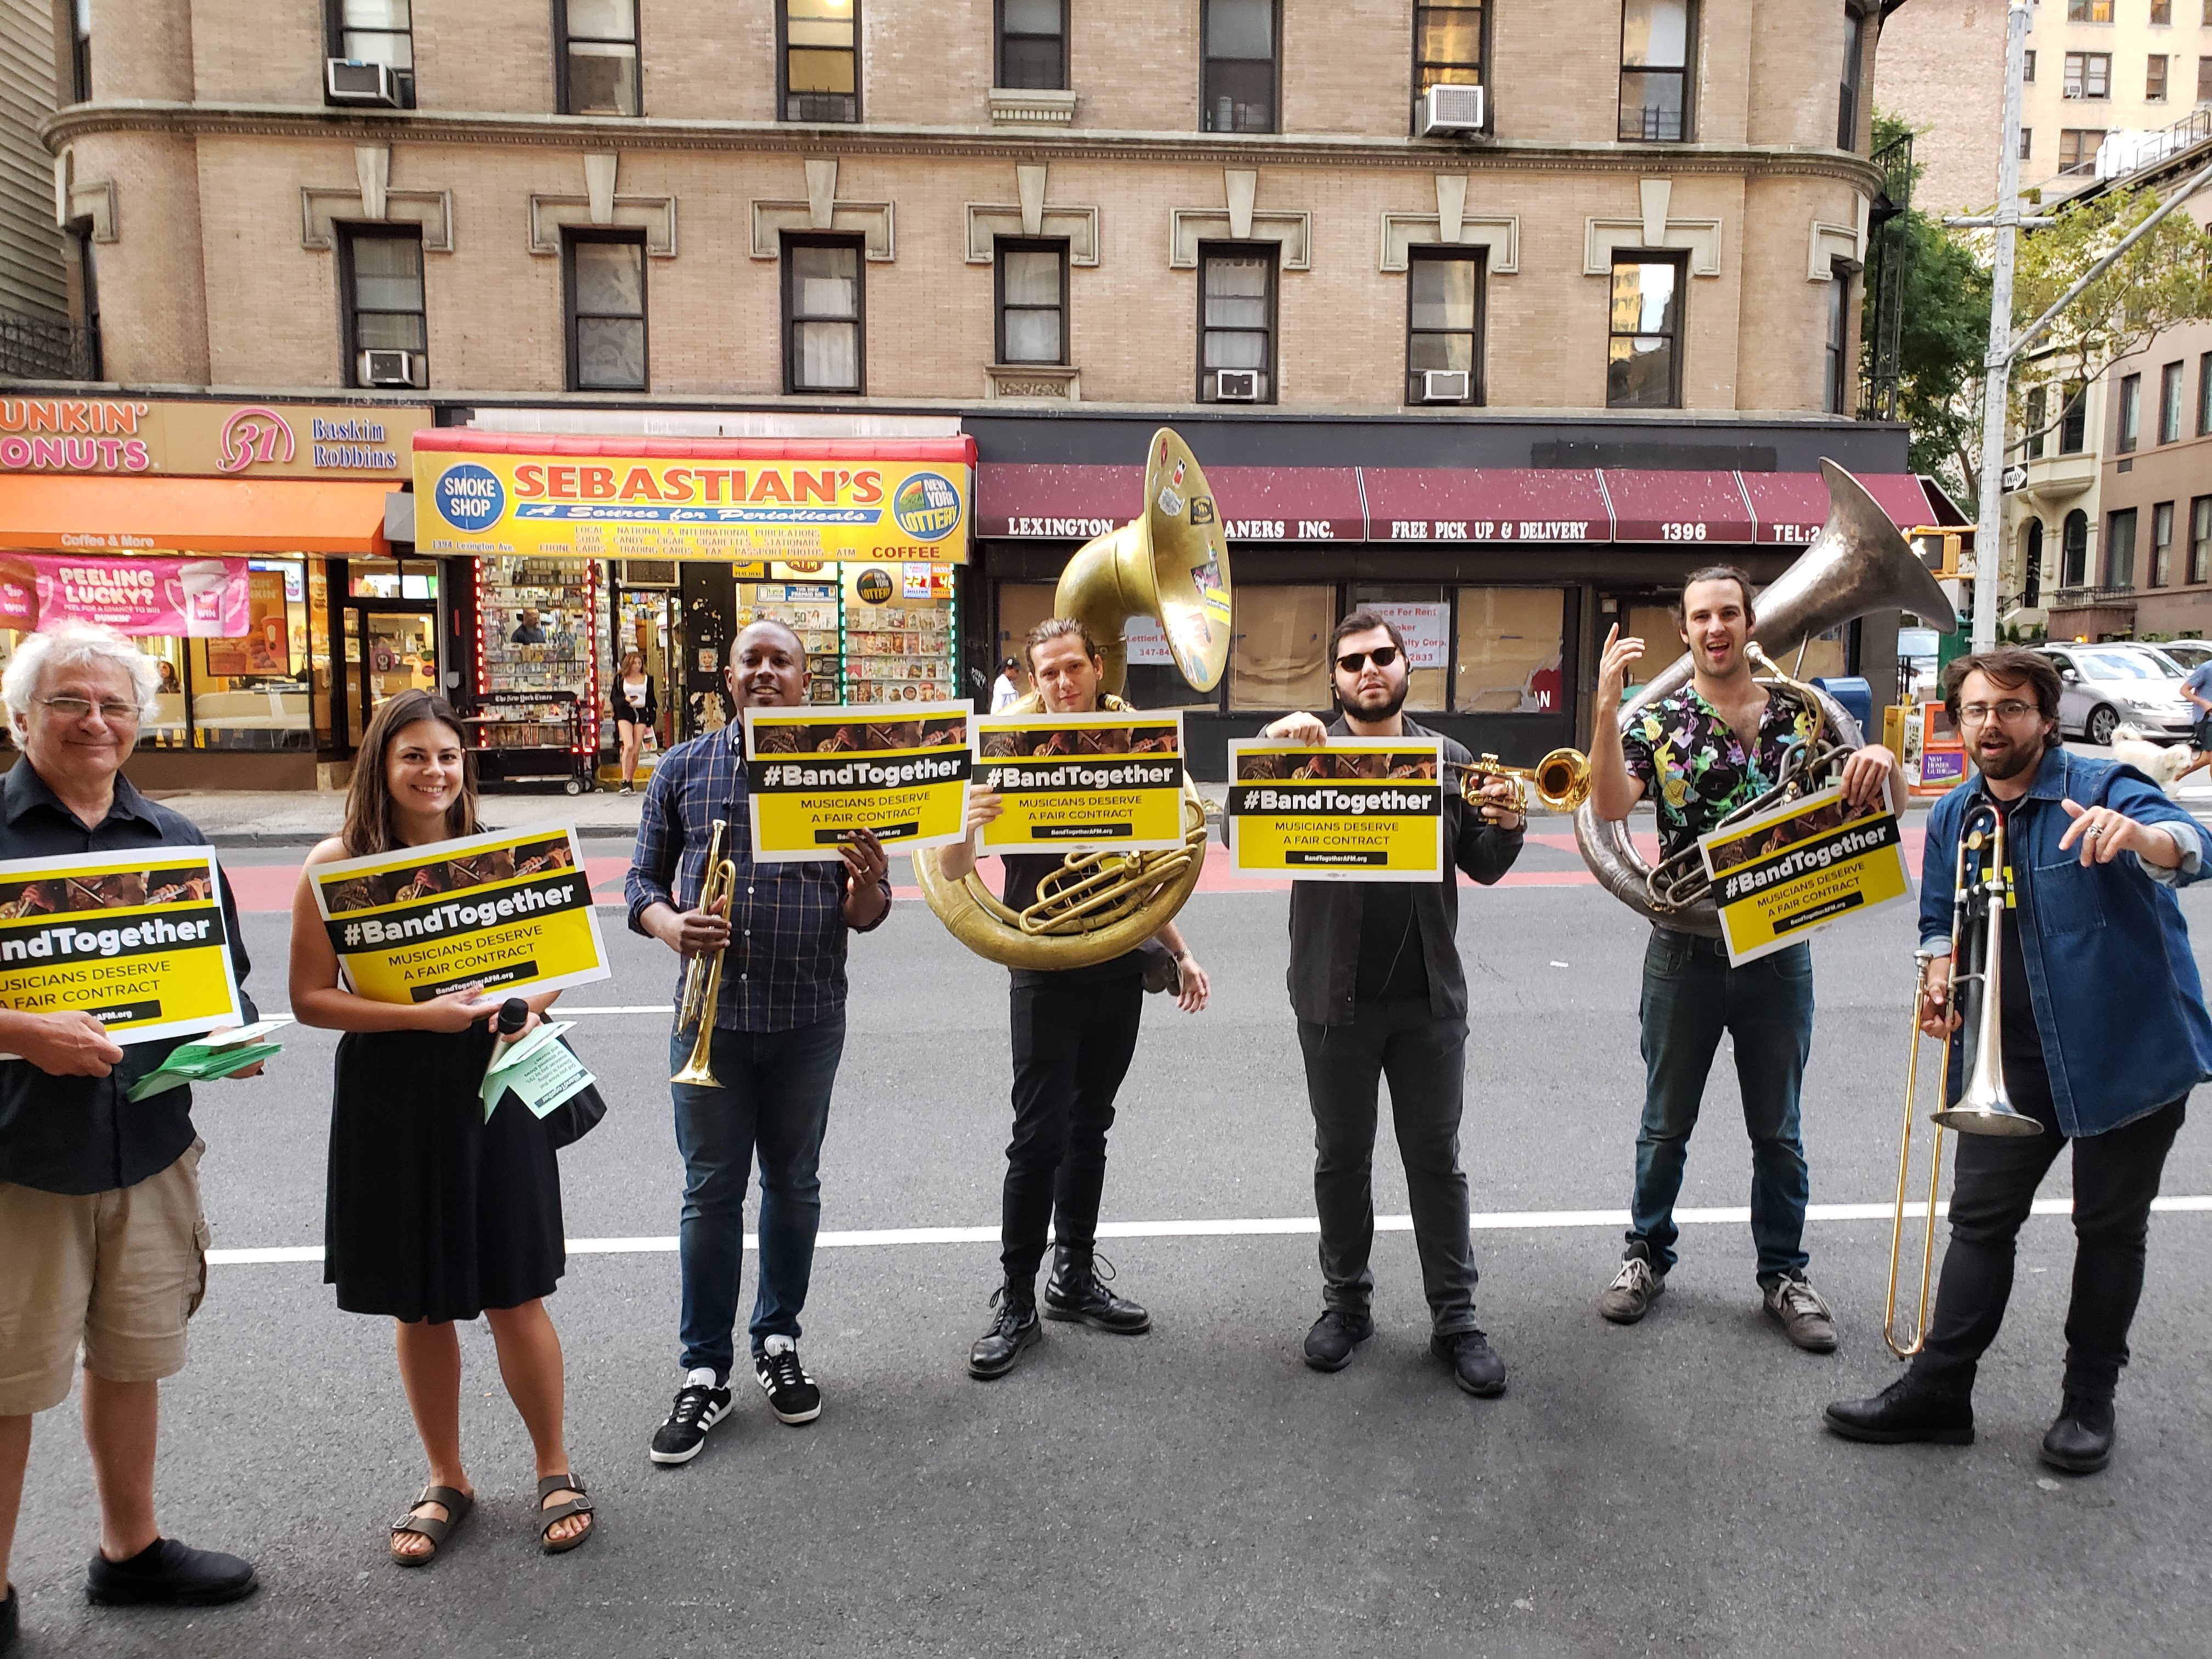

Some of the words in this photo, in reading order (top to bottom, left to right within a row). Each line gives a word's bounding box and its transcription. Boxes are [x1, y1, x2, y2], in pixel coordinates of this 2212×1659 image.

[312, 417, 385, 442] Baskin
[216, 423, 278, 472] 31
[313, 444, 397, 469] Robbins
[514, 464, 884, 506] SEBASTIAN'S
[923, 479, 947, 492] NEW
[2007, 472, 2022, 484] WAY
[444, 477, 496, 497] SMOKE
[450, 498, 491, 517] SHOP
[927, 491, 955, 508] YORK
[526, 505, 557, 517] A
[567, 506, 659, 520] Source
[669, 508, 708, 522] for
[717, 509, 867, 522] Periodicals
[900, 505, 957, 532] LOTTERY
[575, 526, 603, 535] LOCAL
[617, 527, 659, 535] NATIONAL
[666, 527, 674, 535] &
[679, 528, 749, 537] INTERNATIONAL
[755, 529, 820, 538] PUBLICATIONS
[1008, 517, 1114, 537] LEXINGTON
[1224, 521, 1285, 538] ANERS
[1298, 521, 1334, 538] INC.
[1391, 522, 1427, 539] FREE
[1435, 522, 1468, 539] PICK
[1475, 522, 1494, 539] UP
[1501, 522, 1513, 539] &
[1520, 522, 1588, 539] DELIVERY
[1661, 523, 1706, 540] 1396
[61, 534, 105, 546] Coffee
[108, 534, 118, 546] &
[121, 534, 154, 547] More
[456, 540, 494, 551] Lexington
[498, 542, 515, 552] Ave.
[576, 535, 601, 544] SODA
[613, 536, 643, 544] CANDY
[657, 537, 684, 545] CIGAR
[696, 538, 751, 546] CIGARETTES
[764, 538, 820, 547] STATIONARY
[539, 544, 570, 553] PHONE
[575, 545, 606, 554] CARDS
[619, 545, 658, 554] TRADING
[663, 546, 693, 555] CARDS
[705, 548, 723, 556] FAX
[735, 548, 782, 556] PASSPORT
[787, 548, 824, 557] PHOTOS
[836, 548, 856, 557] ATM
[872, 546, 940, 558] COFFEE
[59, 567, 155, 588] PEELING
[905, 574, 930, 589] 227
[65, 585, 154, 605] LUCKY?
[861, 588, 891, 600] LOTTERY
[4, 602, 26, 613] WIN
[196, 609, 216, 618] WIN
[1415, 608, 1437, 616] Rent
[495, 694, 506, 702] The
[520, 694, 534, 703] York
[764, 758, 961, 787] #BandTogether
[987, 764, 1173, 788] #BandTogether
[801, 798, 875, 809] MUSICIANS
[879, 792, 930, 806] DESERVE
[1019, 797, 1085, 808] MUSICIANS
[1088, 795, 1142, 806] DESERVE
[1244, 789, 1432, 815] #BandTogether
[812, 814, 821, 823] A
[825, 812, 853, 823] FAIR
[857, 806, 922, 822] CONTRACT
[1029, 812, 1036, 821] A
[1040, 811, 1065, 820] FAIR
[1069, 809, 1134, 819] CONTRACT
[1275, 821, 1340, 832] MUSICIANS
[1344, 821, 1399, 832] DESERVE
[1283, 836, 1291, 845] A
[1295, 836, 1319, 845] FAIR
[1323, 835, 1390, 845] CONTRACT
[1304, 855, 1368, 863] BandTogetherAFM.org
[1725, 826, 1886, 899] #BandTogether
[1757, 879, 1815, 909] MUSICIANS
[1817, 861, 1865, 885] DESERVE
[1768, 909, 1775, 918] A
[1777, 899, 1801, 915] FAIR
[1803, 877, 1860, 904] CONTRACT
[345, 882, 574, 947] #BandTogether
[0, 918, 210, 961] ndTogether
[388, 941, 472, 967] MUSICIANS
[476, 924, 544, 949] DESERVE
[93, 960, 172, 980] DESERVE
[404, 969, 414, 981] A
[417, 961, 451, 979] FAIR
[455, 942, 535, 969] CONTRACT
[14, 994, 57, 1009] FAIR
[63, 979, 161, 1003] CONTRACT
